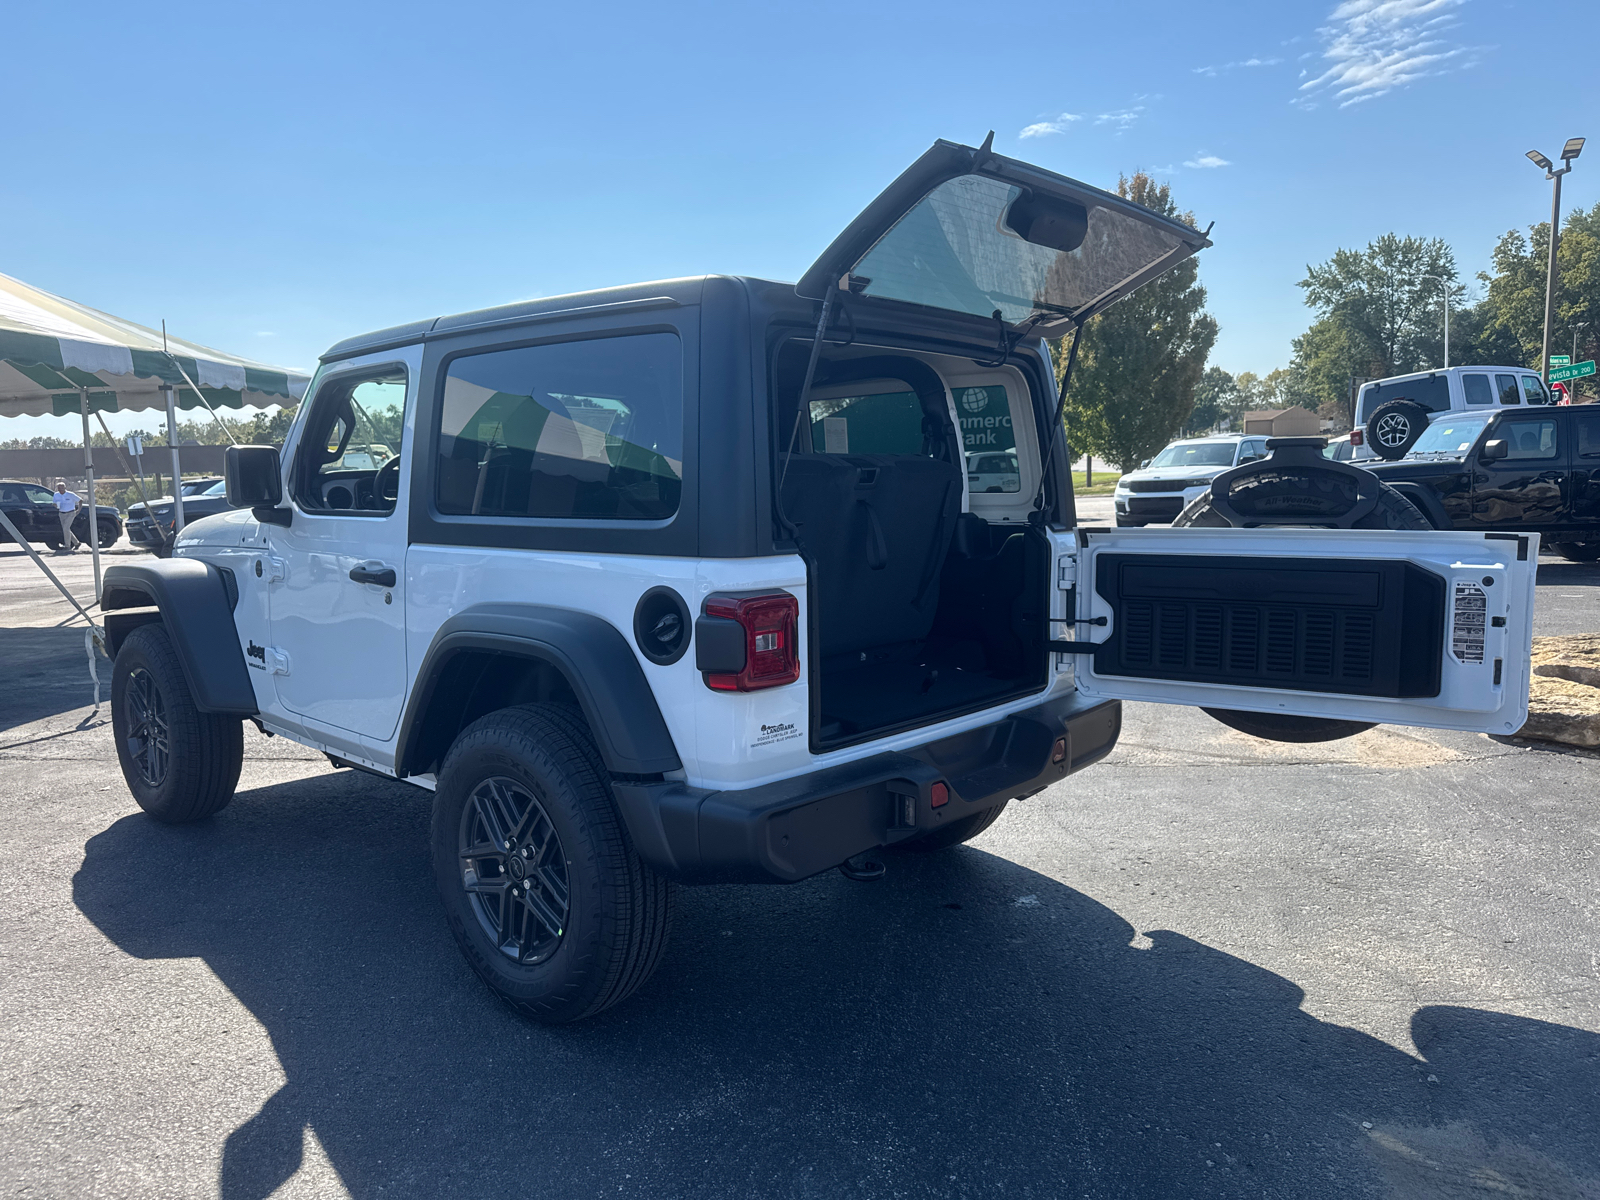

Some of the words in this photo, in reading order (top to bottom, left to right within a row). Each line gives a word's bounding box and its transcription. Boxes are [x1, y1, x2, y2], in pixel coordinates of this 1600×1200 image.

[1548, 370, 1570, 380] evista
[1581, 366, 1591, 374] 200
[1265, 496, 1324, 506] All-Weather
[766, 723, 795, 735] LANDMARK
